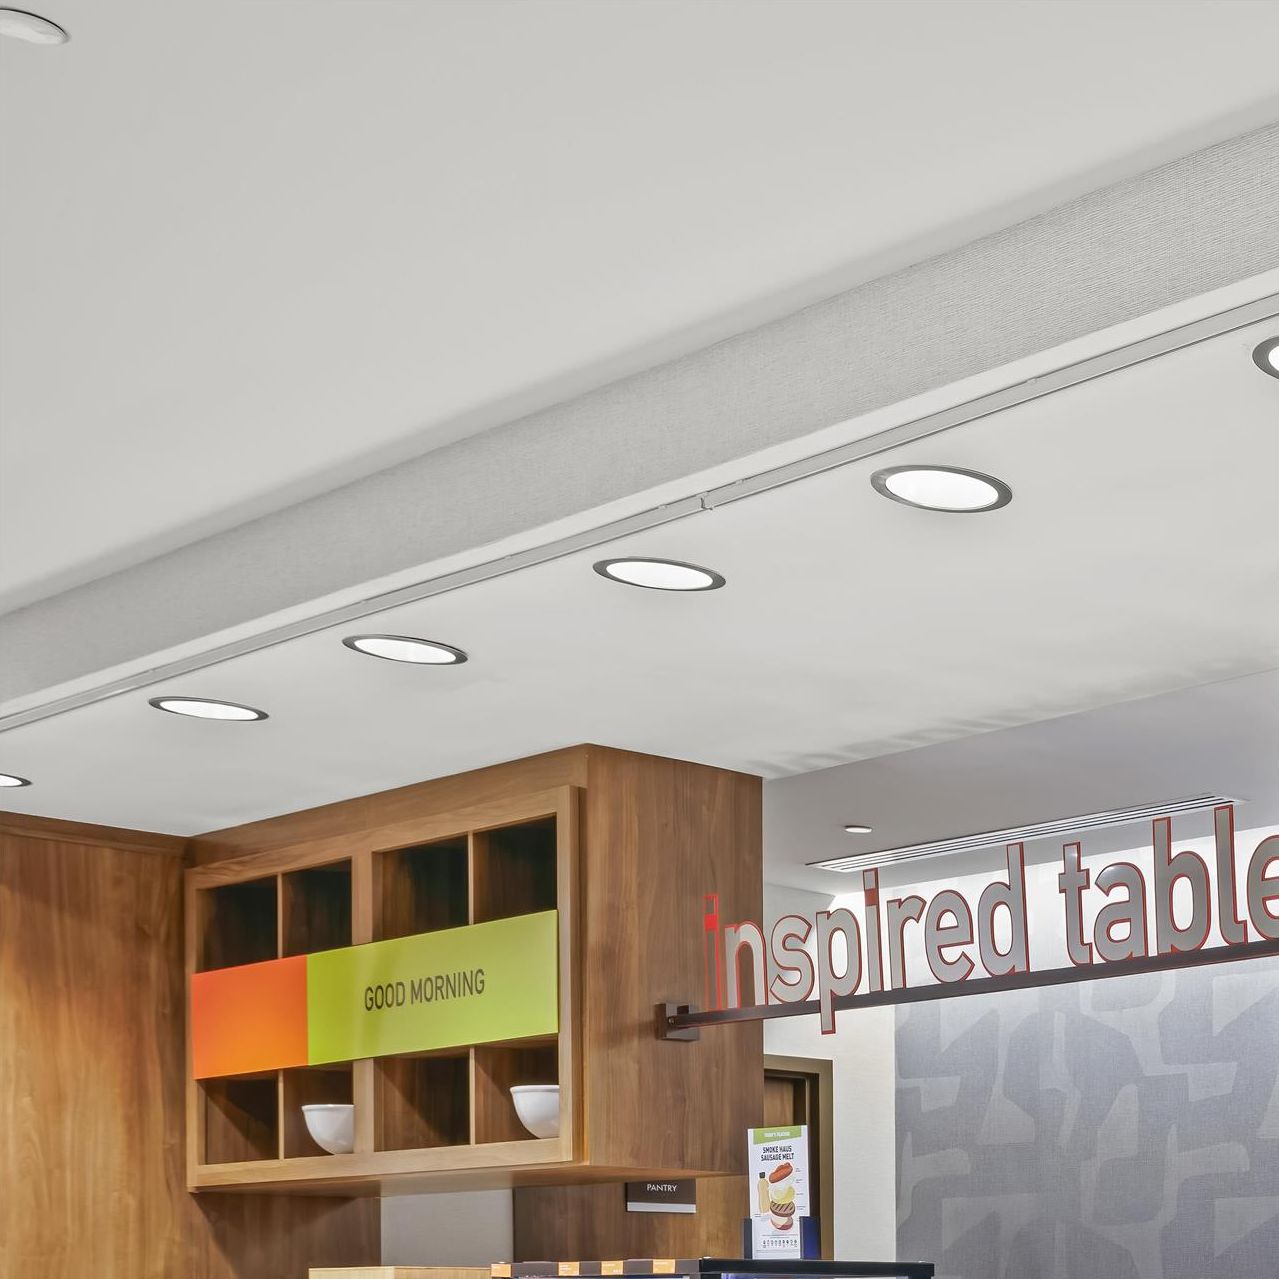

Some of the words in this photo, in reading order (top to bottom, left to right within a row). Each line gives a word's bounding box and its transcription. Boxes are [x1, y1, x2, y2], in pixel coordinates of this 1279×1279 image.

[704, 841, 1030, 1034] inspired
[364, 985, 406, 1011] GOOD
[410, 968, 486, 1005] MORNING
[646, 1183, 678, 1192] PANTRY
